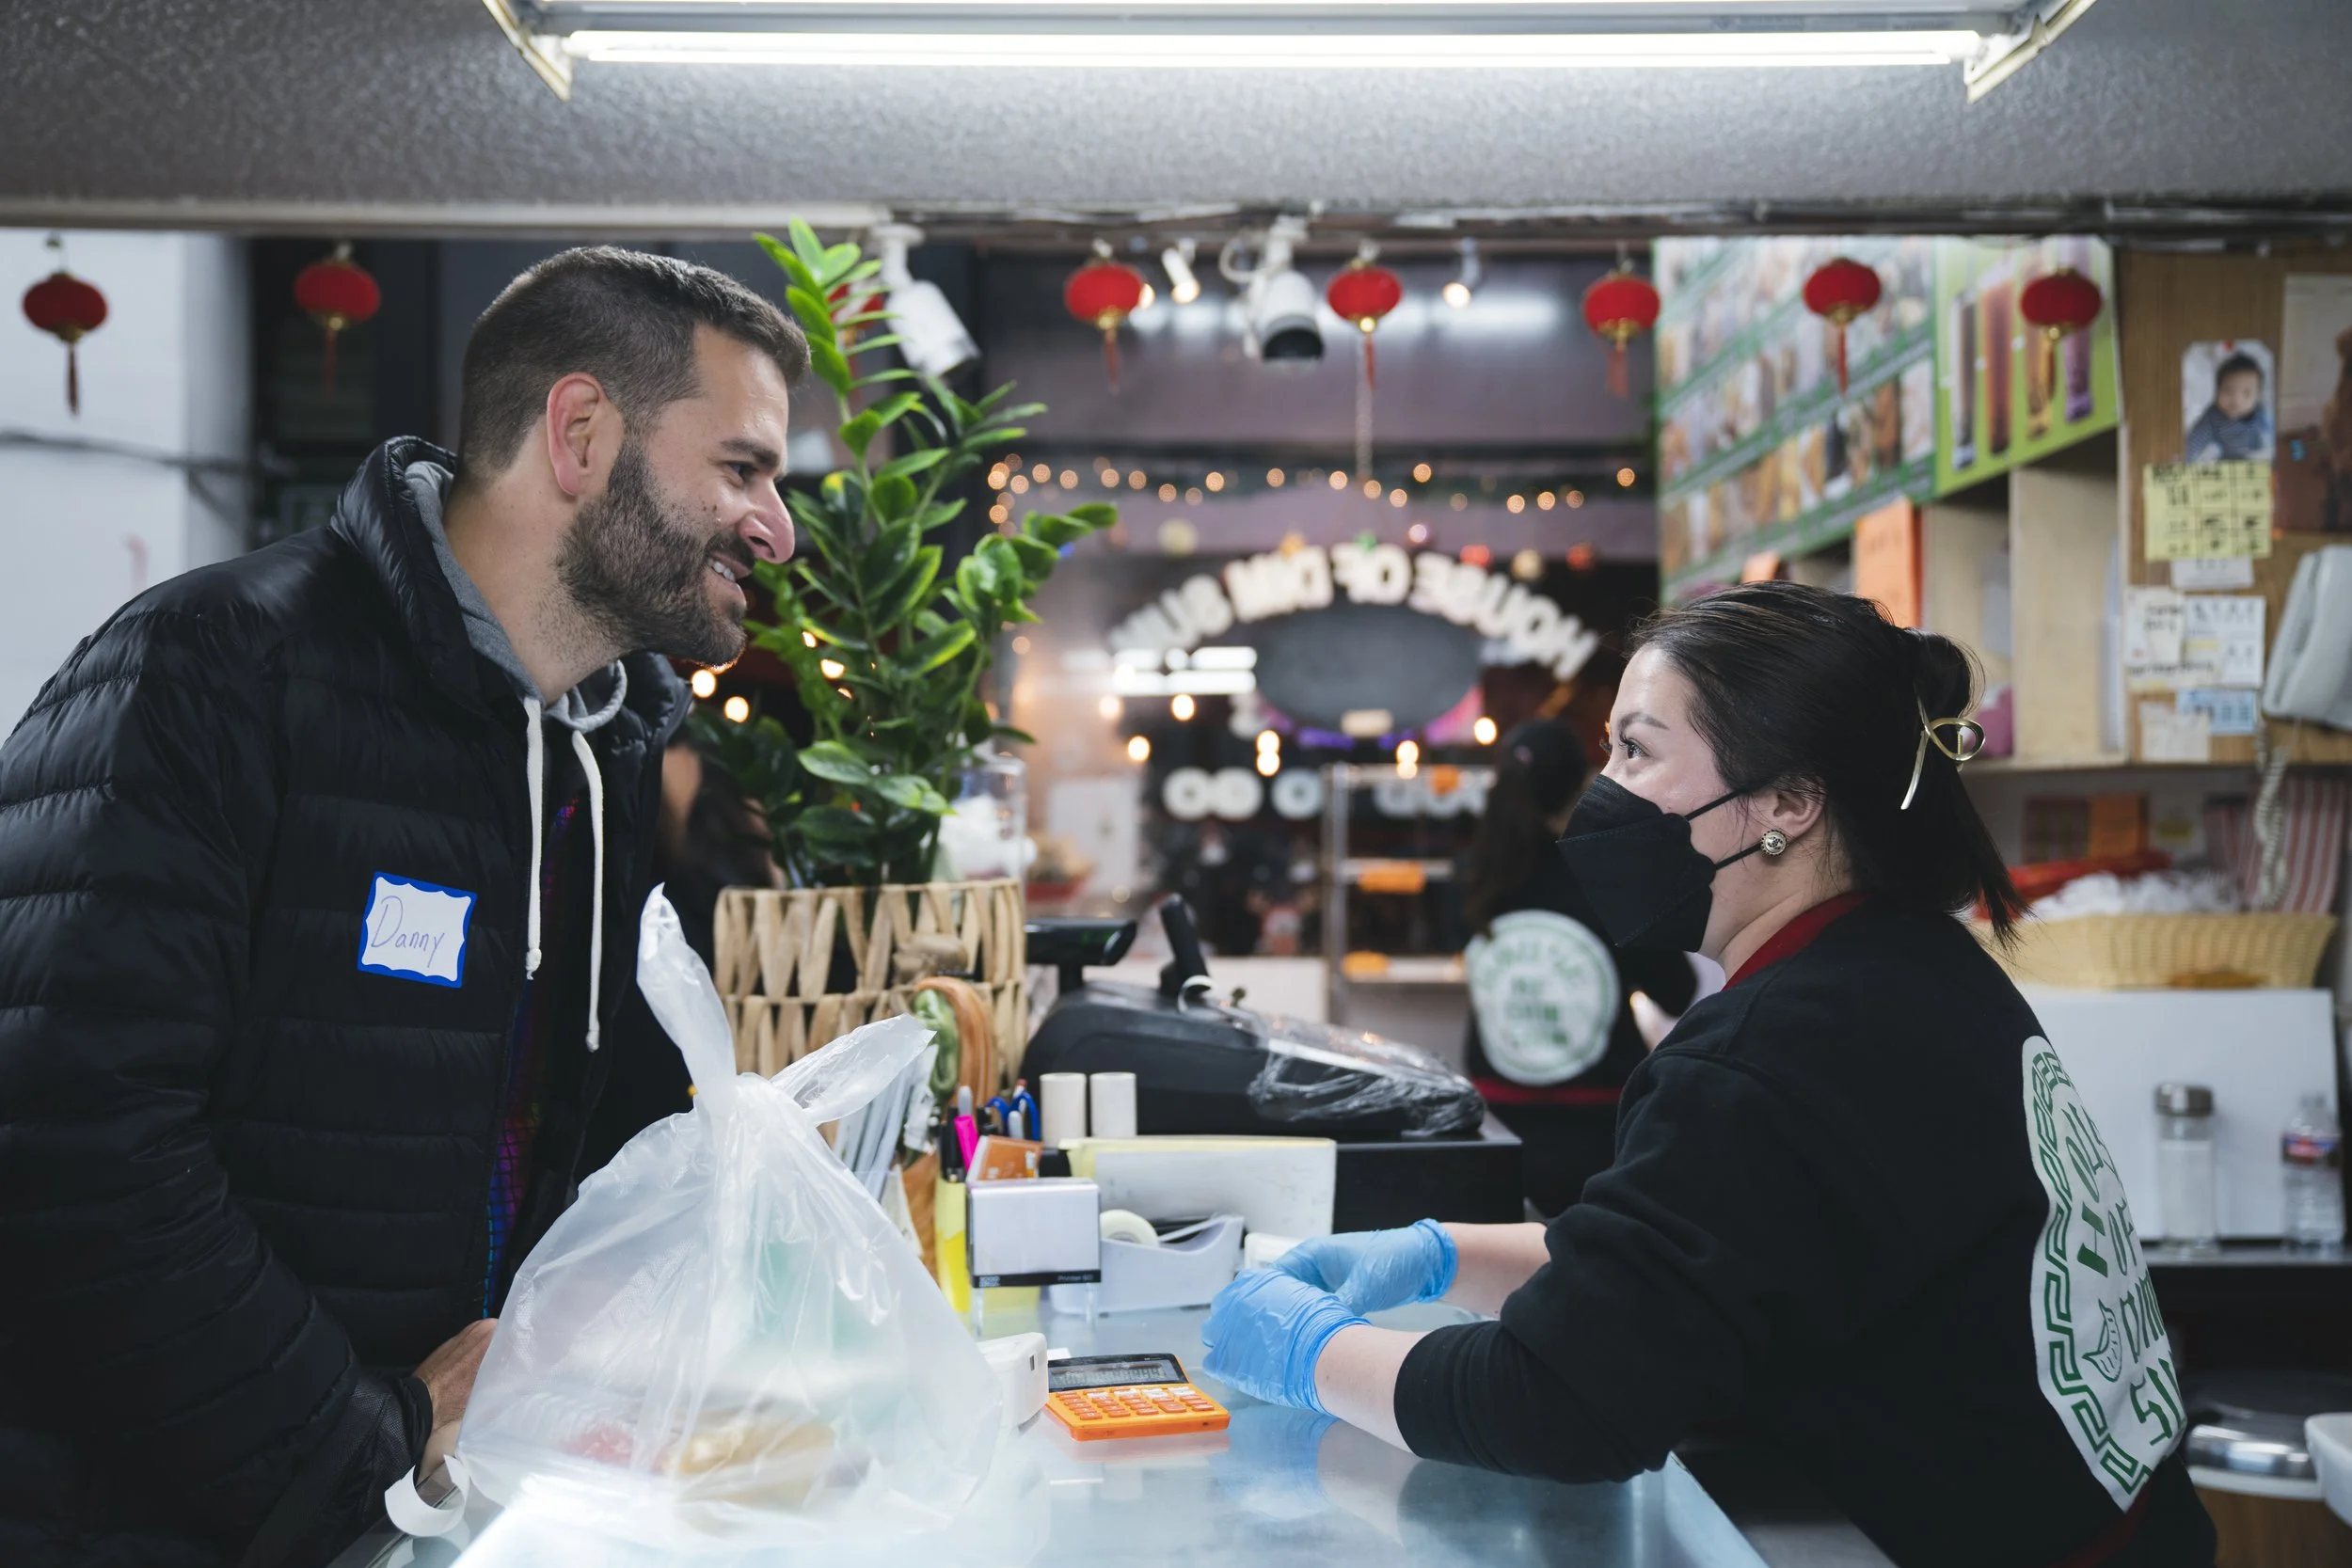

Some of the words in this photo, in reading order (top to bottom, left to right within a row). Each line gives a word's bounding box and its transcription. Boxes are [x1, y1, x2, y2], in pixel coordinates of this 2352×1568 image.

[371, 895, 445, 969] Danny
[2107, 1197, 2137, 1276] OF
[2129, 1348, 2186, 1446] SU
